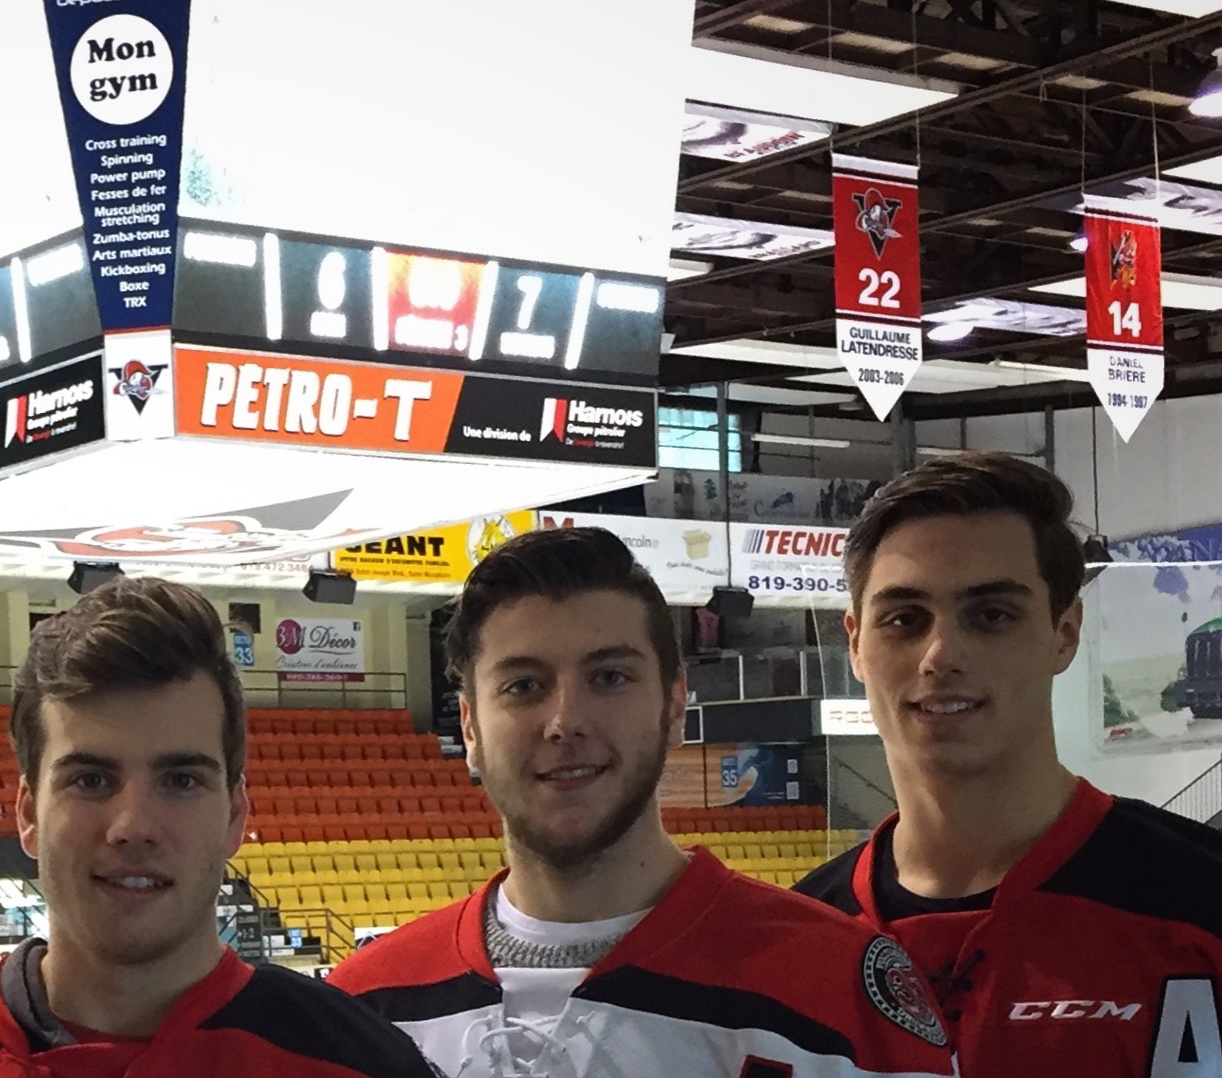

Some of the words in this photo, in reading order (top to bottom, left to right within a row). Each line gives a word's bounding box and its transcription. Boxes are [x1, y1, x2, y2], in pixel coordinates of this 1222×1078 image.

[87, 37, 156, 63] Mon
[89, 72, 158, 102] gym
[85, 139, 117, 151] Cross
[119, 134, 167, 148] training
[100, 152, 154, 168] Spinning
[90, 171, 128, 184] Power
[131, 168, 166, 183] pump
[90, 189, 129, 201] Fesses
[131, 186, 148, 197] de
[149, 184, 167, 196] fer
[94, 202, 166, 217] Musculation
[101, 212, 160, 228] stretching
[92, 229, 170, 244] Zumba-tonus
[92, 249, 117, 261] Arts
[119, 246, 172, 259] martiaux
[100, 262, 166, 277] Kickboxing
[119, 281, 150, 292] Boxe
[858, 267, 900, 308] 22
[123, 296, 147, 308] TRX
[1107, 300, 1142, 337] 14
[849, 327, 911, 344] GUILLAUME
[841, 340, 919, 360] LATENDRESSE
[463, 425, 482, 438] Une
[483, 427, 518, 442] division
[519, 431, 532, 442] de
[308, 625, 357, 648] Décor
[722, 769, 738, 787] 35
[1008, 1000, 1142, 1022] CCM
